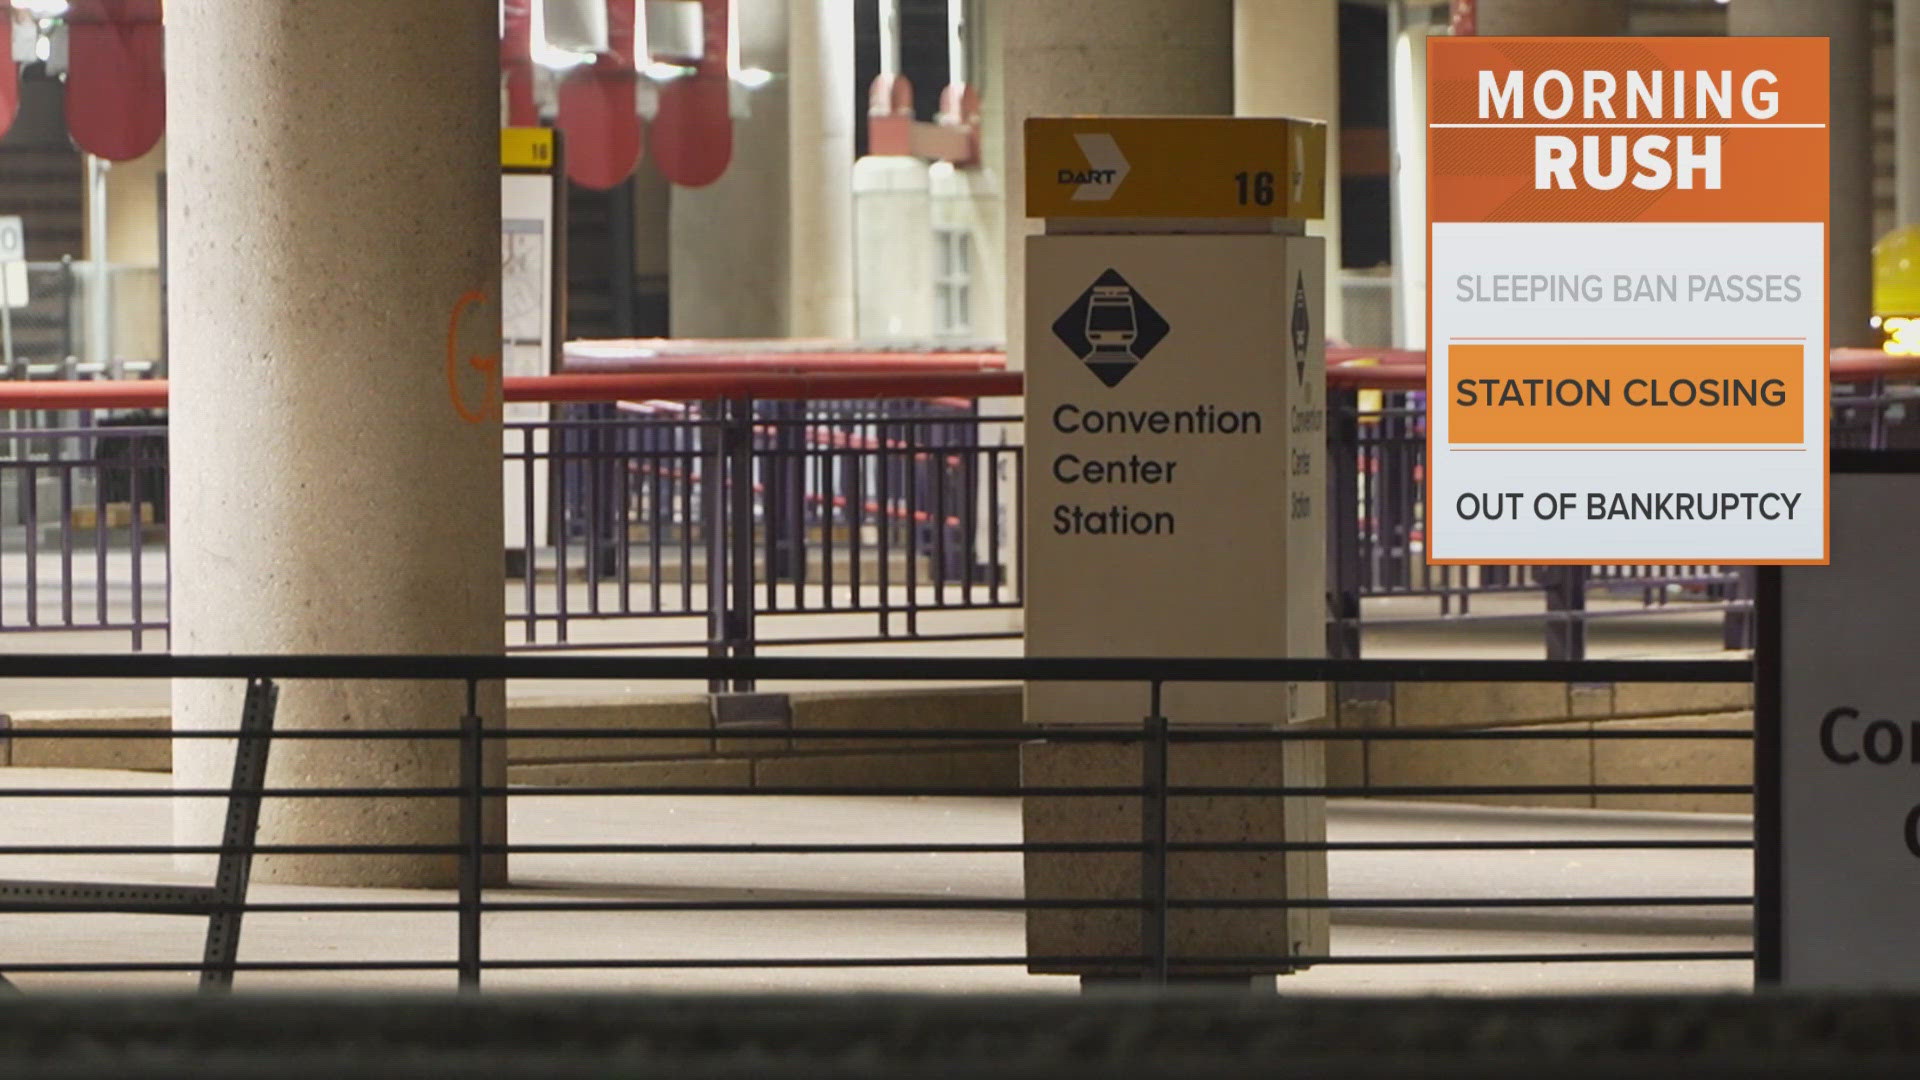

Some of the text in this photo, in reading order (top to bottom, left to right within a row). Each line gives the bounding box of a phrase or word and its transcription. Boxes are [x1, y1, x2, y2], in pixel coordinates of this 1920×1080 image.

[1057, 169, 1116, 184] DART
[1235, 171, 1275, 206] 16
[1053, 403, 1262, 434] Convention
[1053, 453, 1177, 484] Center
[1053, 504, 1175, 535] Station
[1819, 706, 1920, 765] Co
